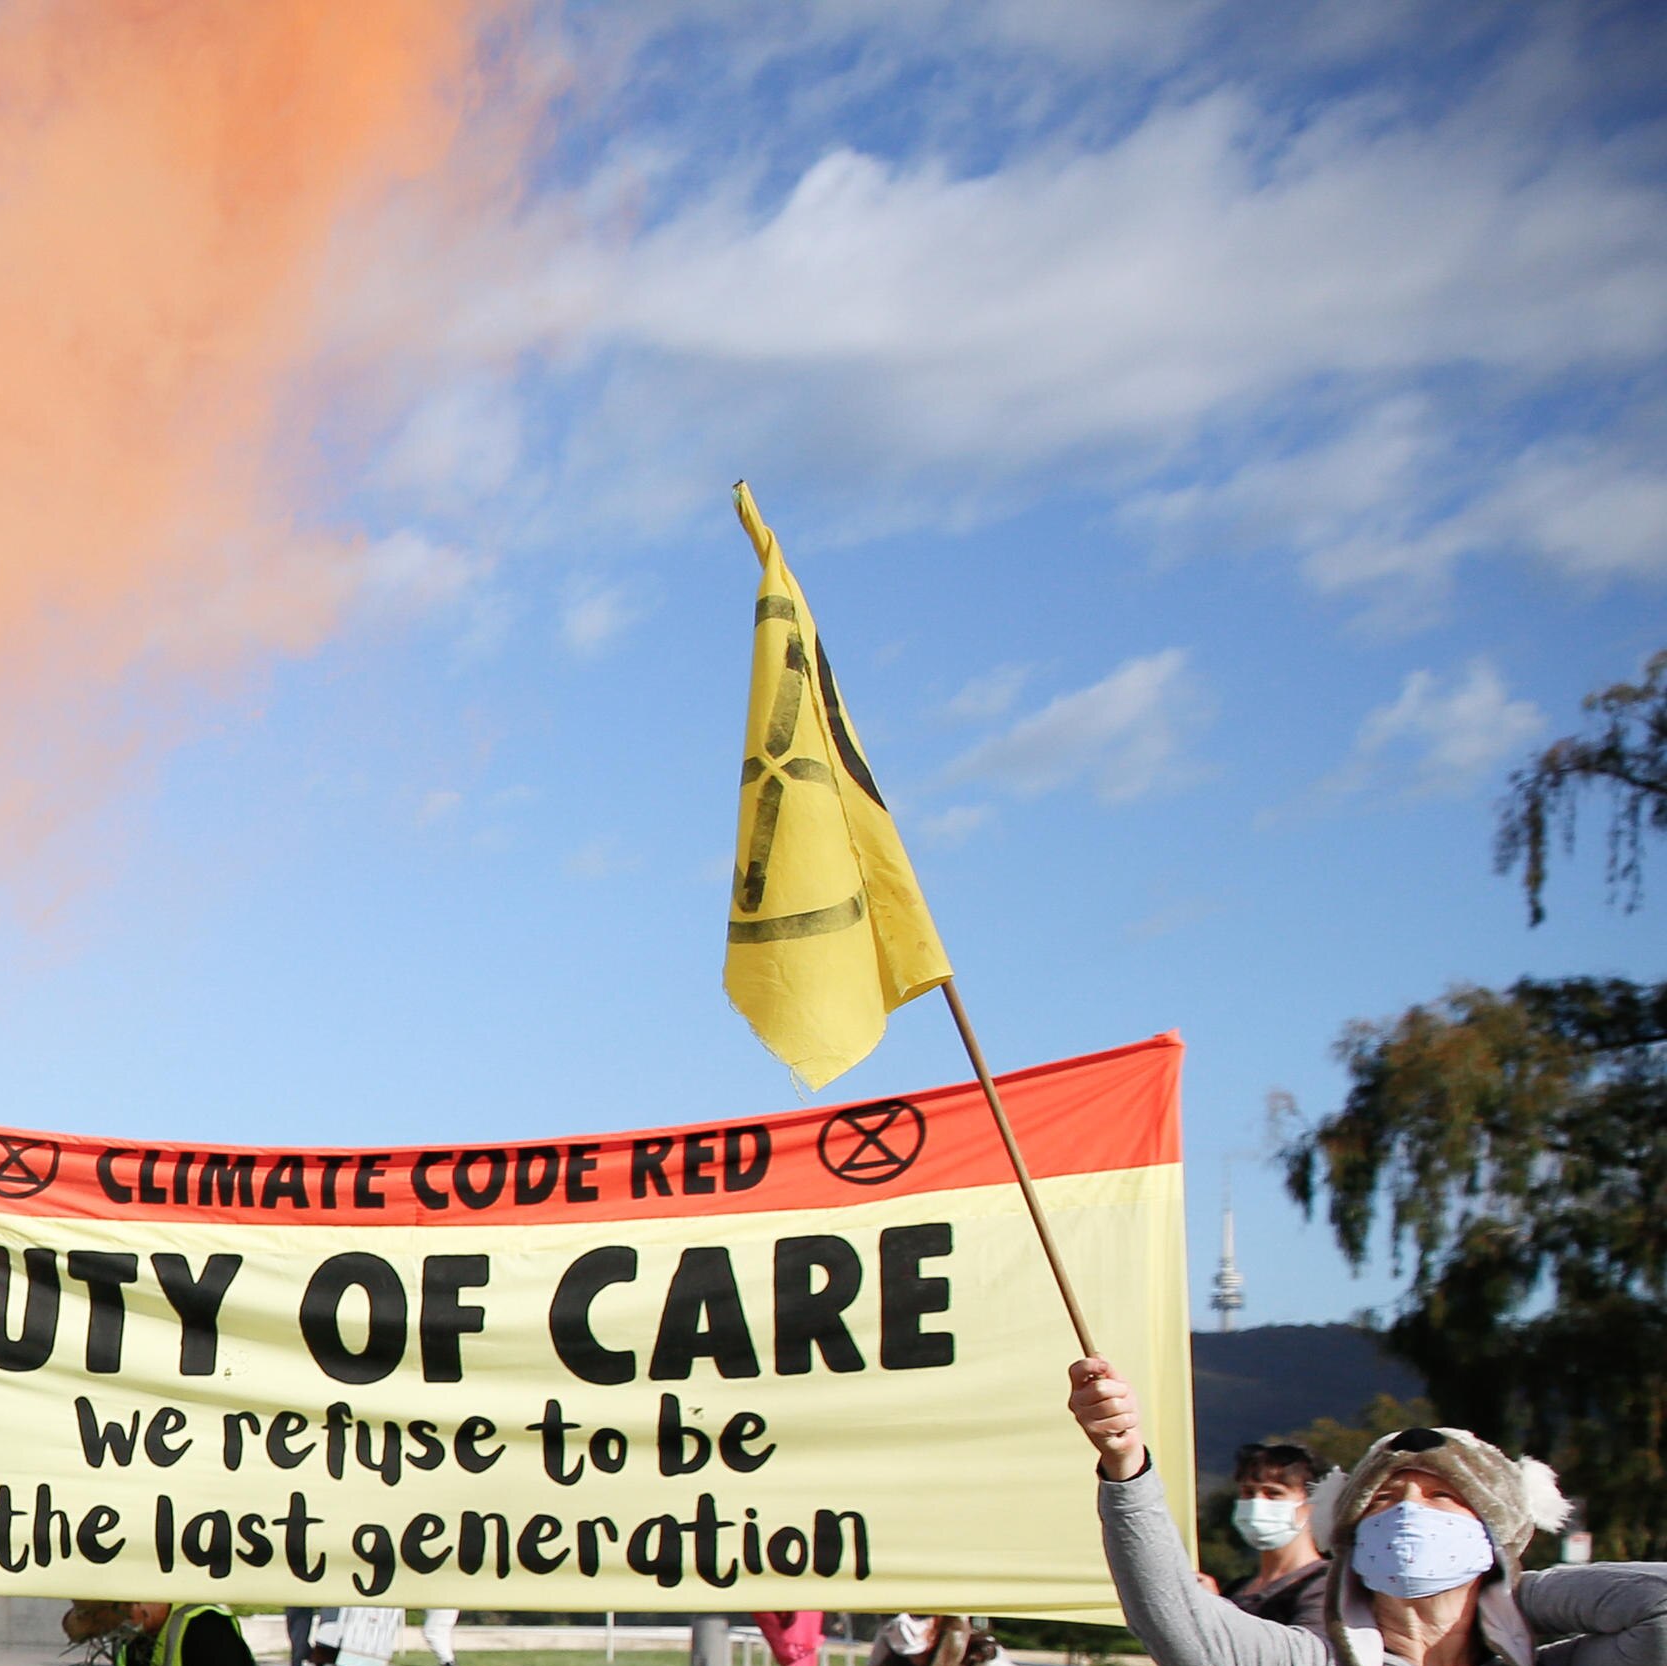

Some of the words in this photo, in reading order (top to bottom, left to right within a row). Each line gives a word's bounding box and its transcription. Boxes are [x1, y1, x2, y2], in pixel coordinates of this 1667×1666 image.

[97, 1147, 392, 1209] CLIMATE
[412, 1143, 601, 1210] CODE
[631, 1124, 772, 1199] RED
[298, 1251, 490, 1386] OF
[548, 1222, 956, 1386] CARE
[223, 1399, 507, 1487] refuse
[525, 1398, 628, 1486] to
[657, 1392, 777, 1477] be
[155, 1493, 326, 1584] last
[352, 1491, 870, 1598] generation
